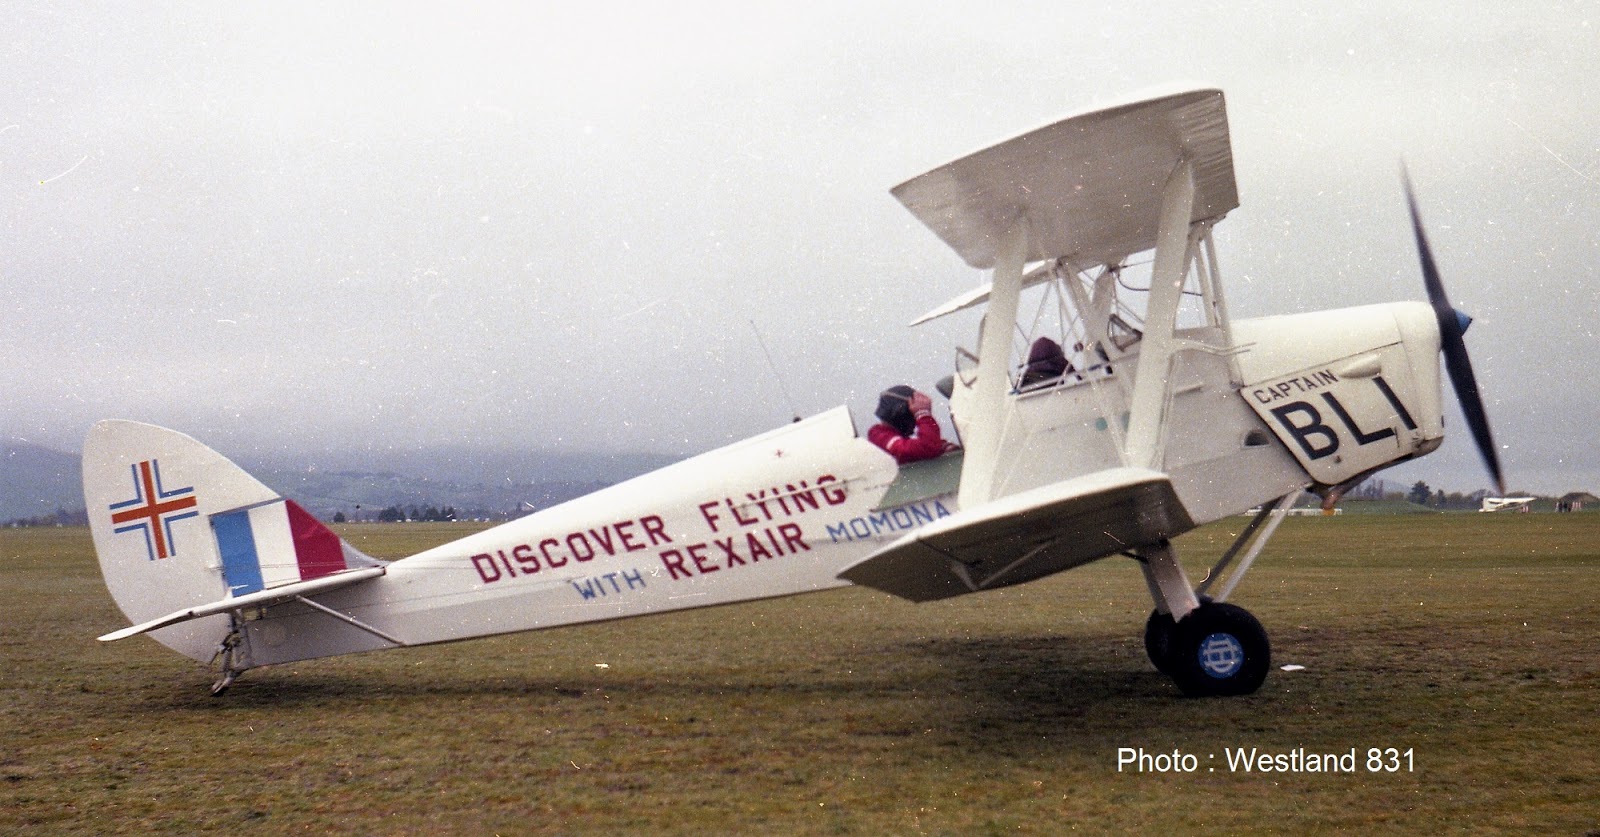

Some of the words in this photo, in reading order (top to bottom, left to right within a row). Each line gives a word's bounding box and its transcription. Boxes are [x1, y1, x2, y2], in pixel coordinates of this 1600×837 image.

[1254, 369, 1339, 404] CAPTAIN
[471, 515, 671, 583] DISCOVER
[700, 475, 847, 533] FLYING
[573, 567, 646, 601] WITH
[661, 523, 811, 580] REXAIR
[825, 500, 950, 542] MOMONA
